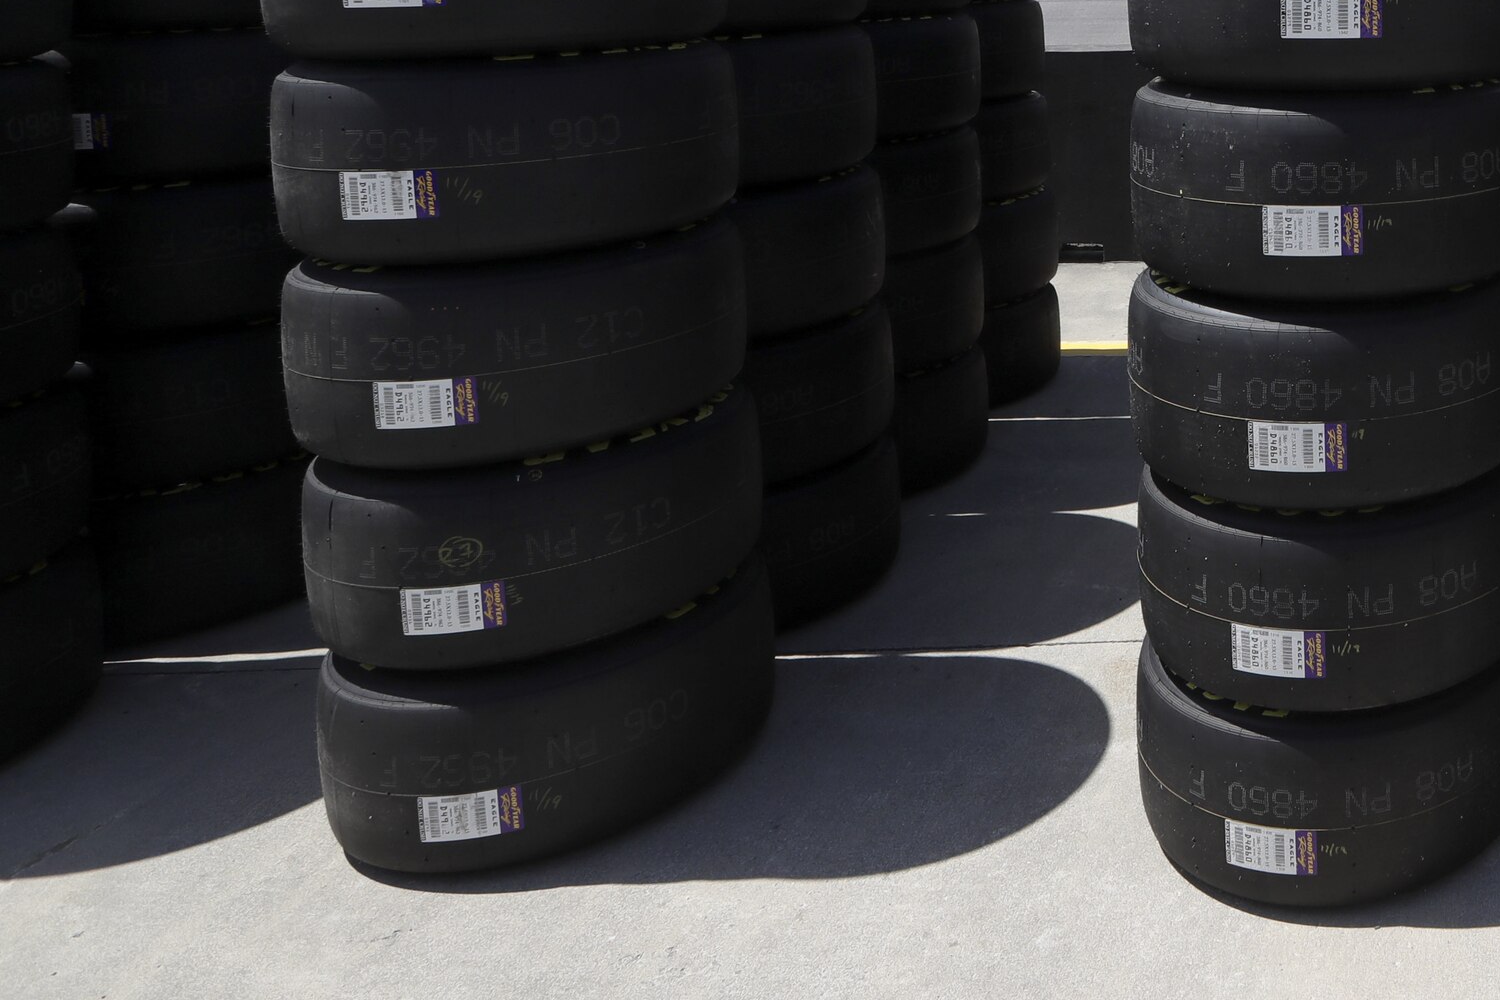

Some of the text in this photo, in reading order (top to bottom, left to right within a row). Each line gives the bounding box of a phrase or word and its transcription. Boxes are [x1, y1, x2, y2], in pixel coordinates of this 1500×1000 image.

[1225, 159, 1246, 193] F
[1270, 160, 1368, 195] 4860
[1395, 155, 1439, 189] PN
[1202, 351, 1491, 411] A08 PN 4860 F
[445, 388, 453, 418] EAGLE
[1269, 433, 1278, 464] D4860
[1227, 582, 1320, 621] 4860
[1346, 583, 1395, 620] PN
[1417, 561, 1478, 607] A08
[1415, 751, 1474, 800] A08
[490, 798, 498, 827] EAGLE
[1227, 782, 1318, 819] 4860
[1344, 782, 1391, 818] PN
